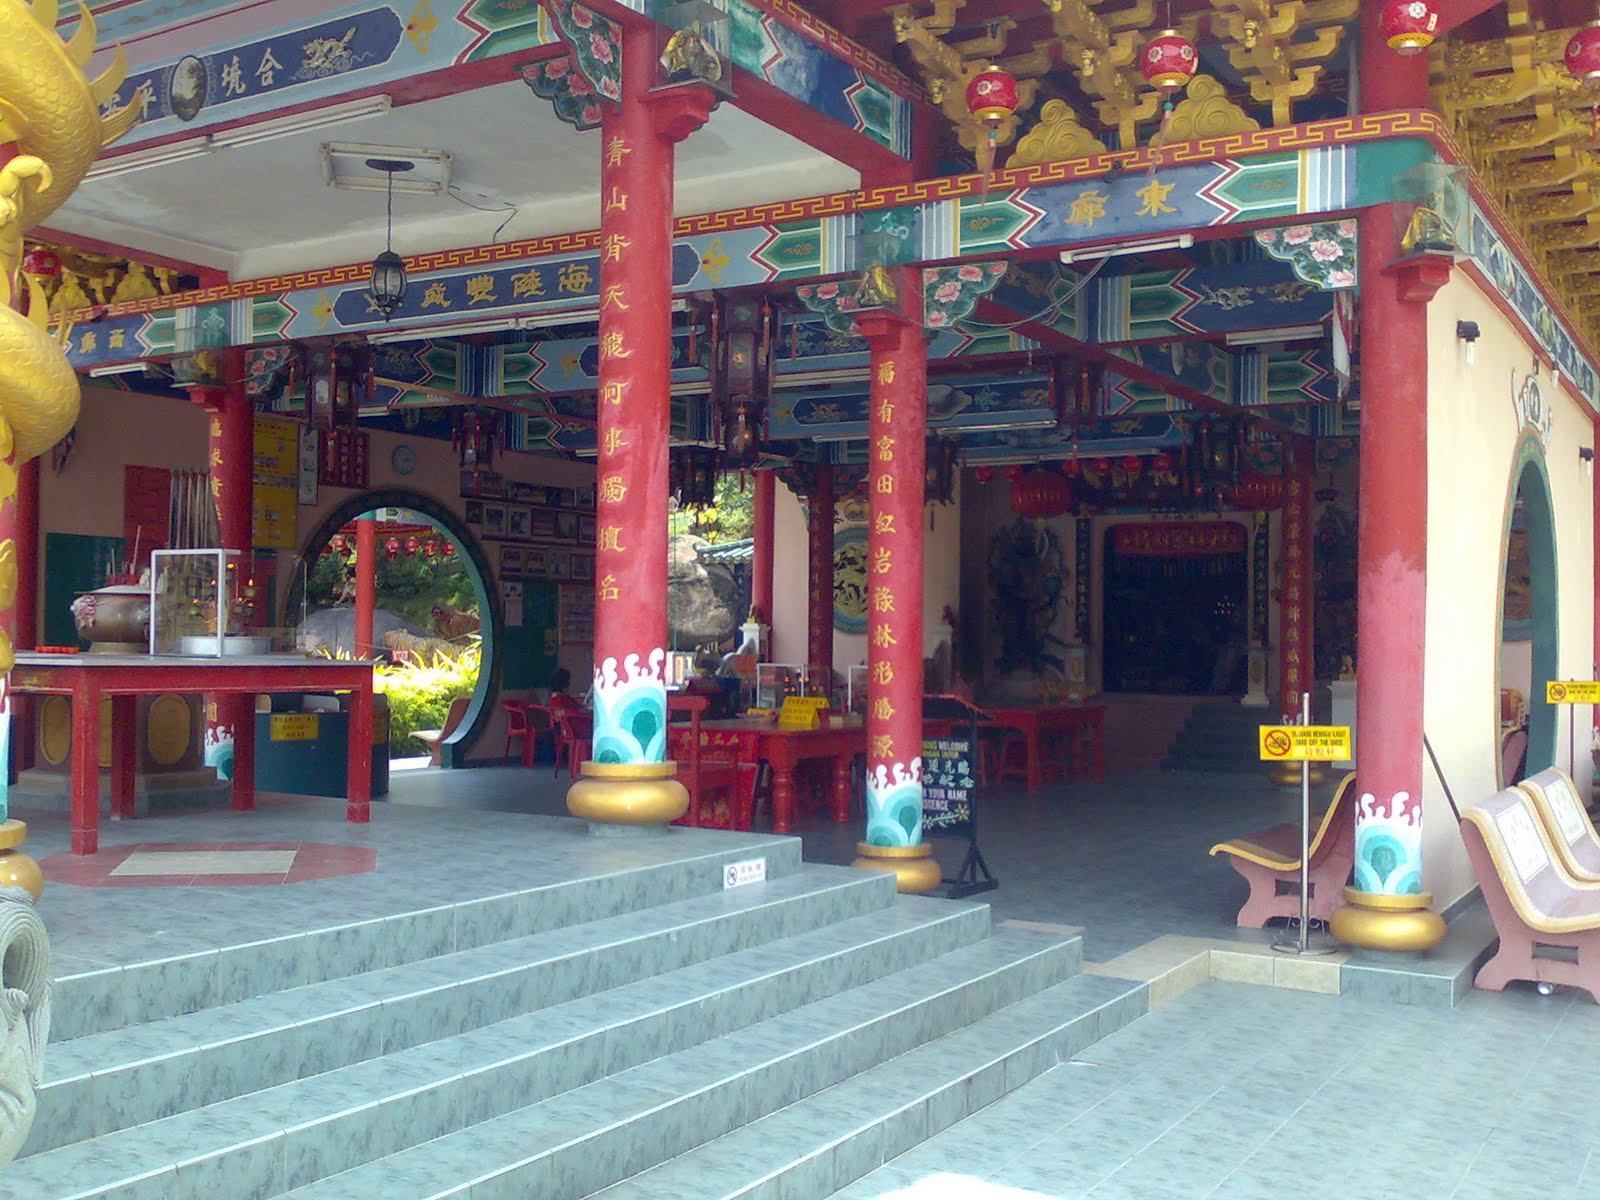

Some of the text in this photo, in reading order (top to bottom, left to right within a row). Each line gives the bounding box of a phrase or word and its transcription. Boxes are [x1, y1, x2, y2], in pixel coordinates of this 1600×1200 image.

[938, 741, 969, 753] WELCOME
[928, 788, 946, 799] YOUR
[947, 789, 968, 801] NAME
